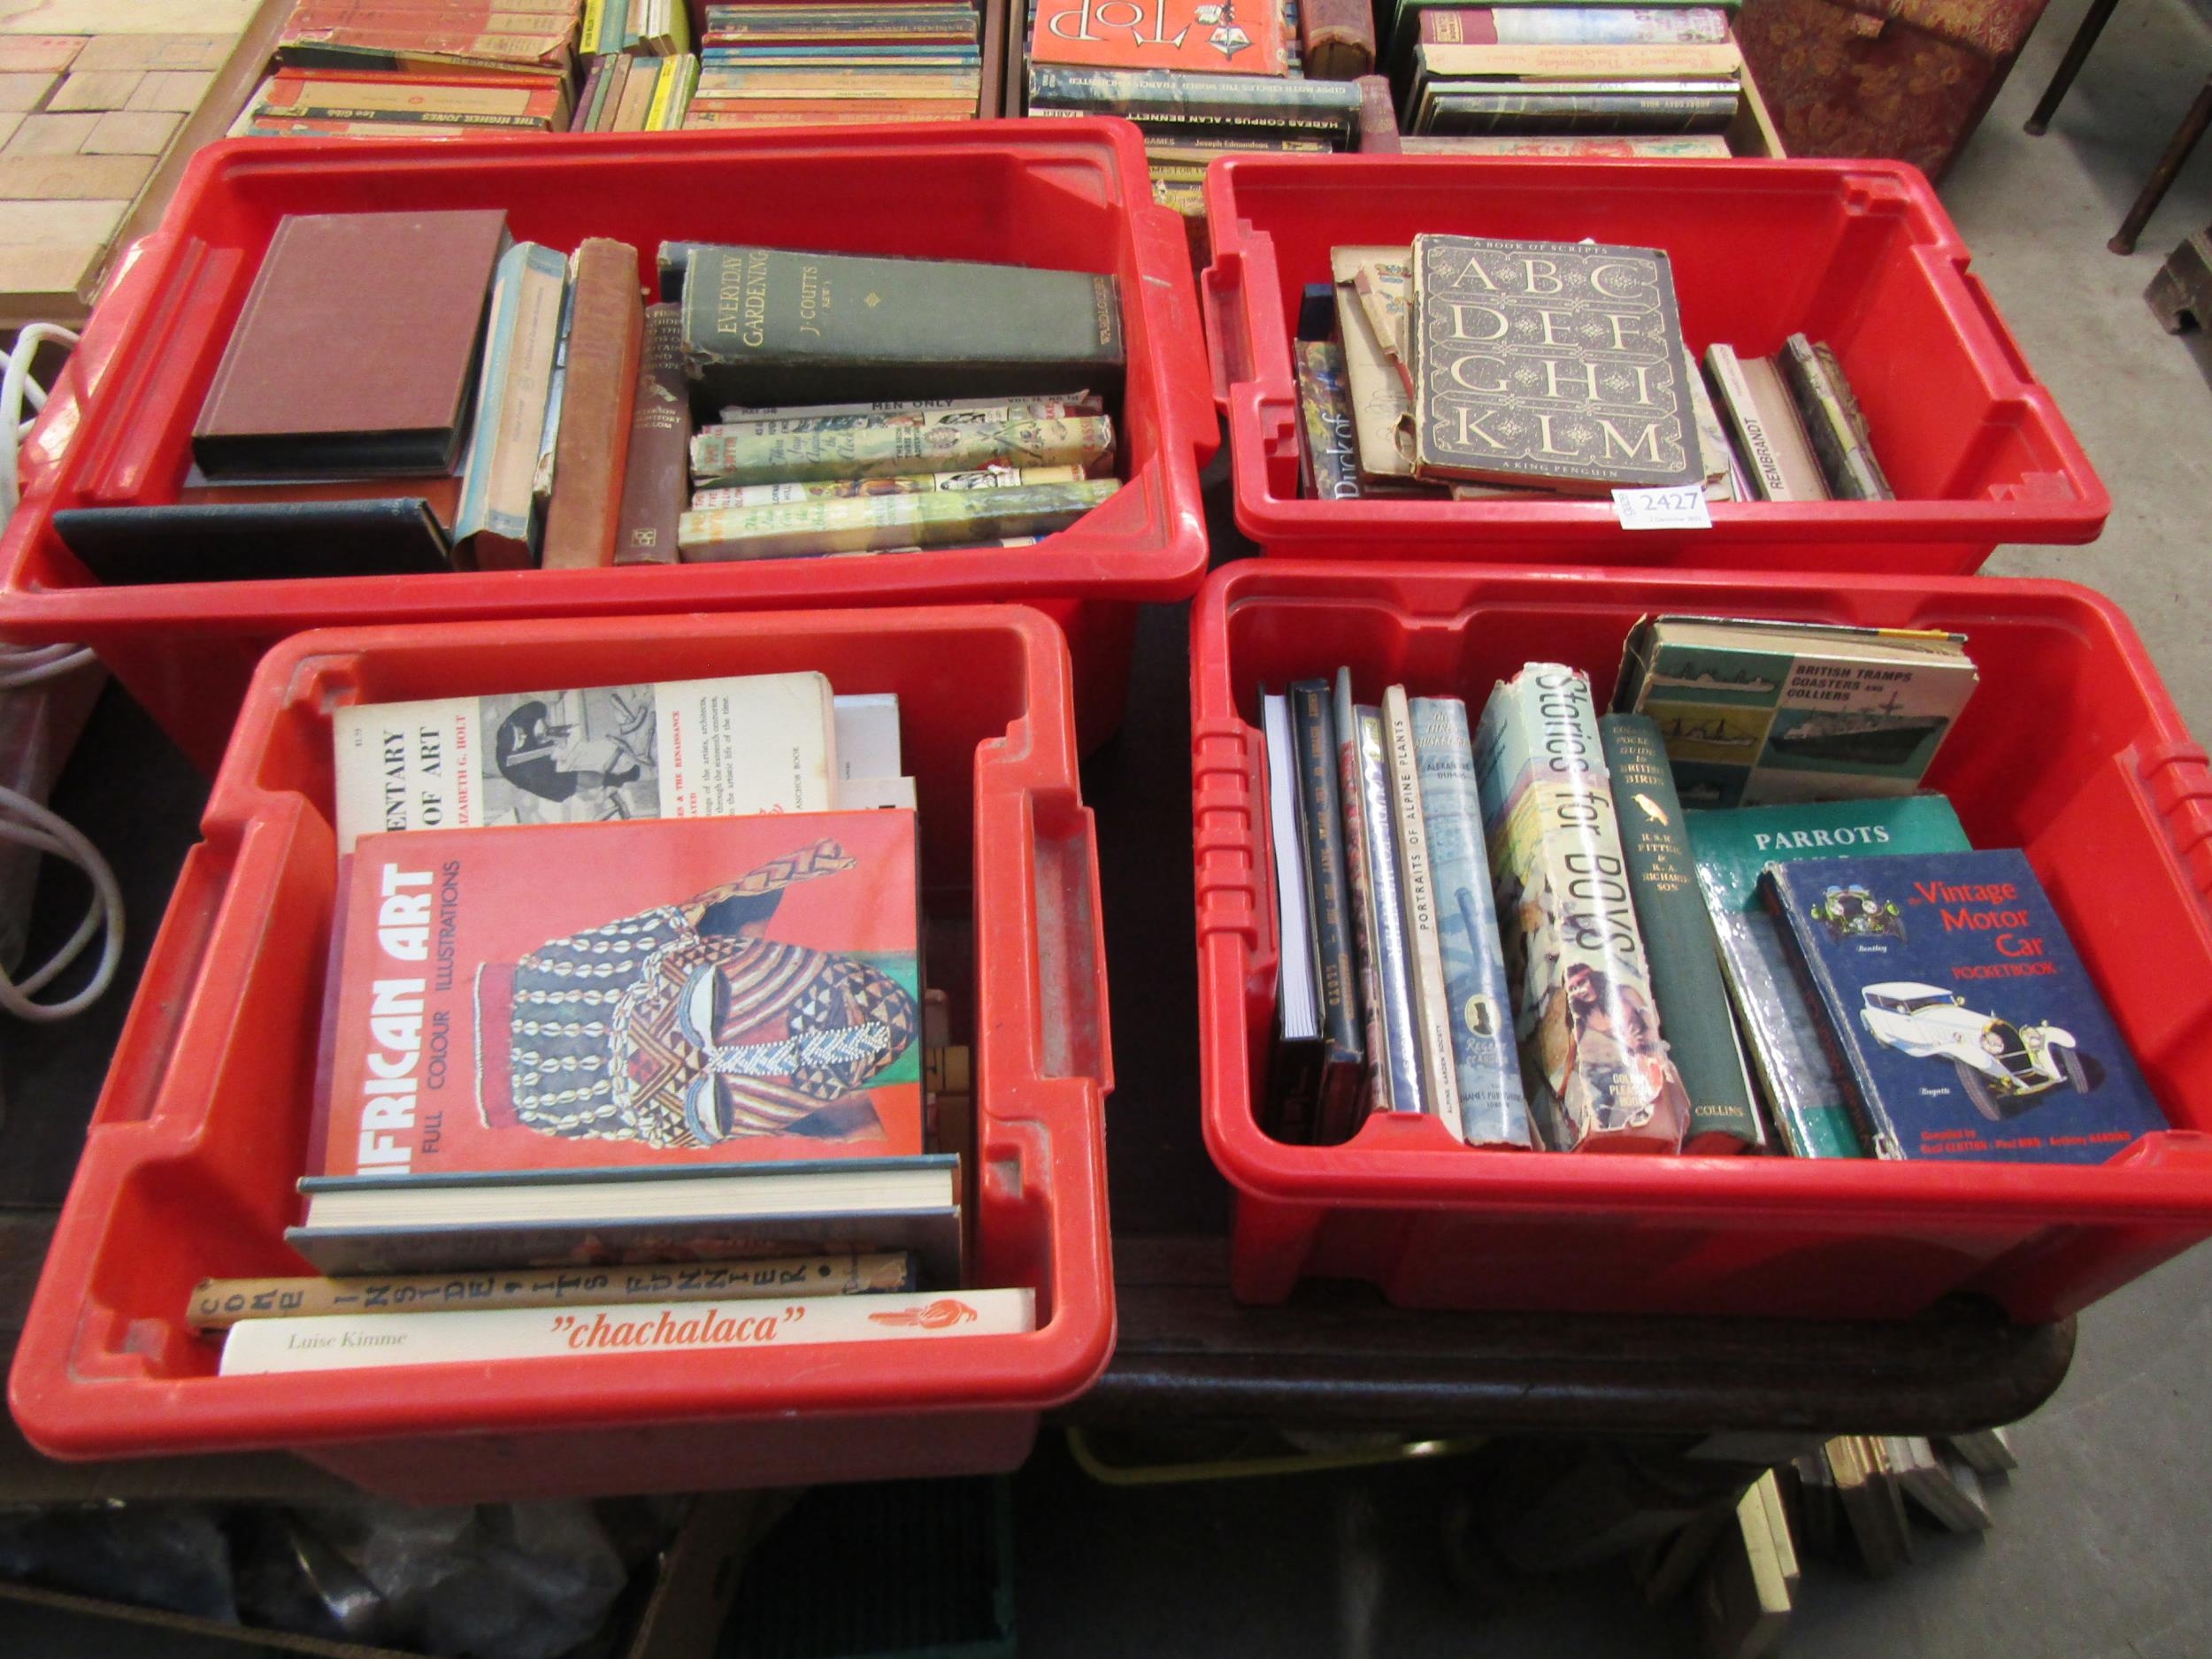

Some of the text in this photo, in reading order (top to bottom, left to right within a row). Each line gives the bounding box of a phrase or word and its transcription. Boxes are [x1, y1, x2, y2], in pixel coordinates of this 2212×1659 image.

[420, 112, 463, 123] JONES
[1125, 112, 1339, 129] HABEAS CORPUS ALAN BENNETT
[1194, 138, 1223, 149] Joseph
[1486, 242, 1523, 250] BOOK
[1551, 245, 1609, 255] SCRIPTS
[1451, 257, 1643, 299] A B C
[718, 253, 744, 335] EVERYDAY
[742, 250, 770, 349] GARDENING
[1450, 304, 1641, 350] D E F
[1450, 355, 1653, 405] G H I
[872, 397, 954, 411] MEN ONLY
[1454, 407, 1666, 464] K L M
[1744, 418, 1786, 490] REMBRANDT
[1513, 461, 1548, 472] KING
[1554, 465, 1618, 478] PENGUIN
[1640, 492, 1699, 511] 2427
[1791, 677, 1862, 691] COASTERS
[1795, 664, 1913, 682] BRITISH TRAMPS
[1786, 688, 1851, 702] COLLIERS
[455, 714, 467, 749] HOLT
[1534, 672, 1593, 775] Stories
[672, 710, 684, 768] RENAISSANCE
[384, 729, 408, 833] ENTARY
[419, 726, 442, 826] OF ART
[675, 773, 684, 791] THE
[700, 769, 710, 781] the
[792, 745, 803, 810] ANCHOR BOOK
[1625, 774, 1665, 787] BIRDS
[456, 769, 469, 828] IZABETH
[1393, 718, 1431, 932] PORTRAITS OF ALPINE PLANTS
[1555, 789, 1610, 837] for
[1754, 825, 1891, 851] PARROTS
[1914, 880, 2018, 906] Vintage
[379, 863, 434, 962] ART
[1939, 907, 2030, 933] Motor
[1856, 943, 1888, 955] Bentley
[1995, 933, 2046, 958] Car
[1952, 961, 2057, 980] POCKETBOOK
[421, 859, 461, 1155] FULL COLOUR ILLUSTRATIONS
[1435, 1024, 1444, 1057] SOCIETY
[1445, 1087, 1454, 1115] ALPINE
[1694, 1105, 1744, 1118] COLLINS
[200, 1289, 303, 1316] COME
[334, 1277, 495, 1308] INSIDE
[626, 1264, 809, 1295] FUNNIER
[341, 1330, 408, 1348] Kimme
